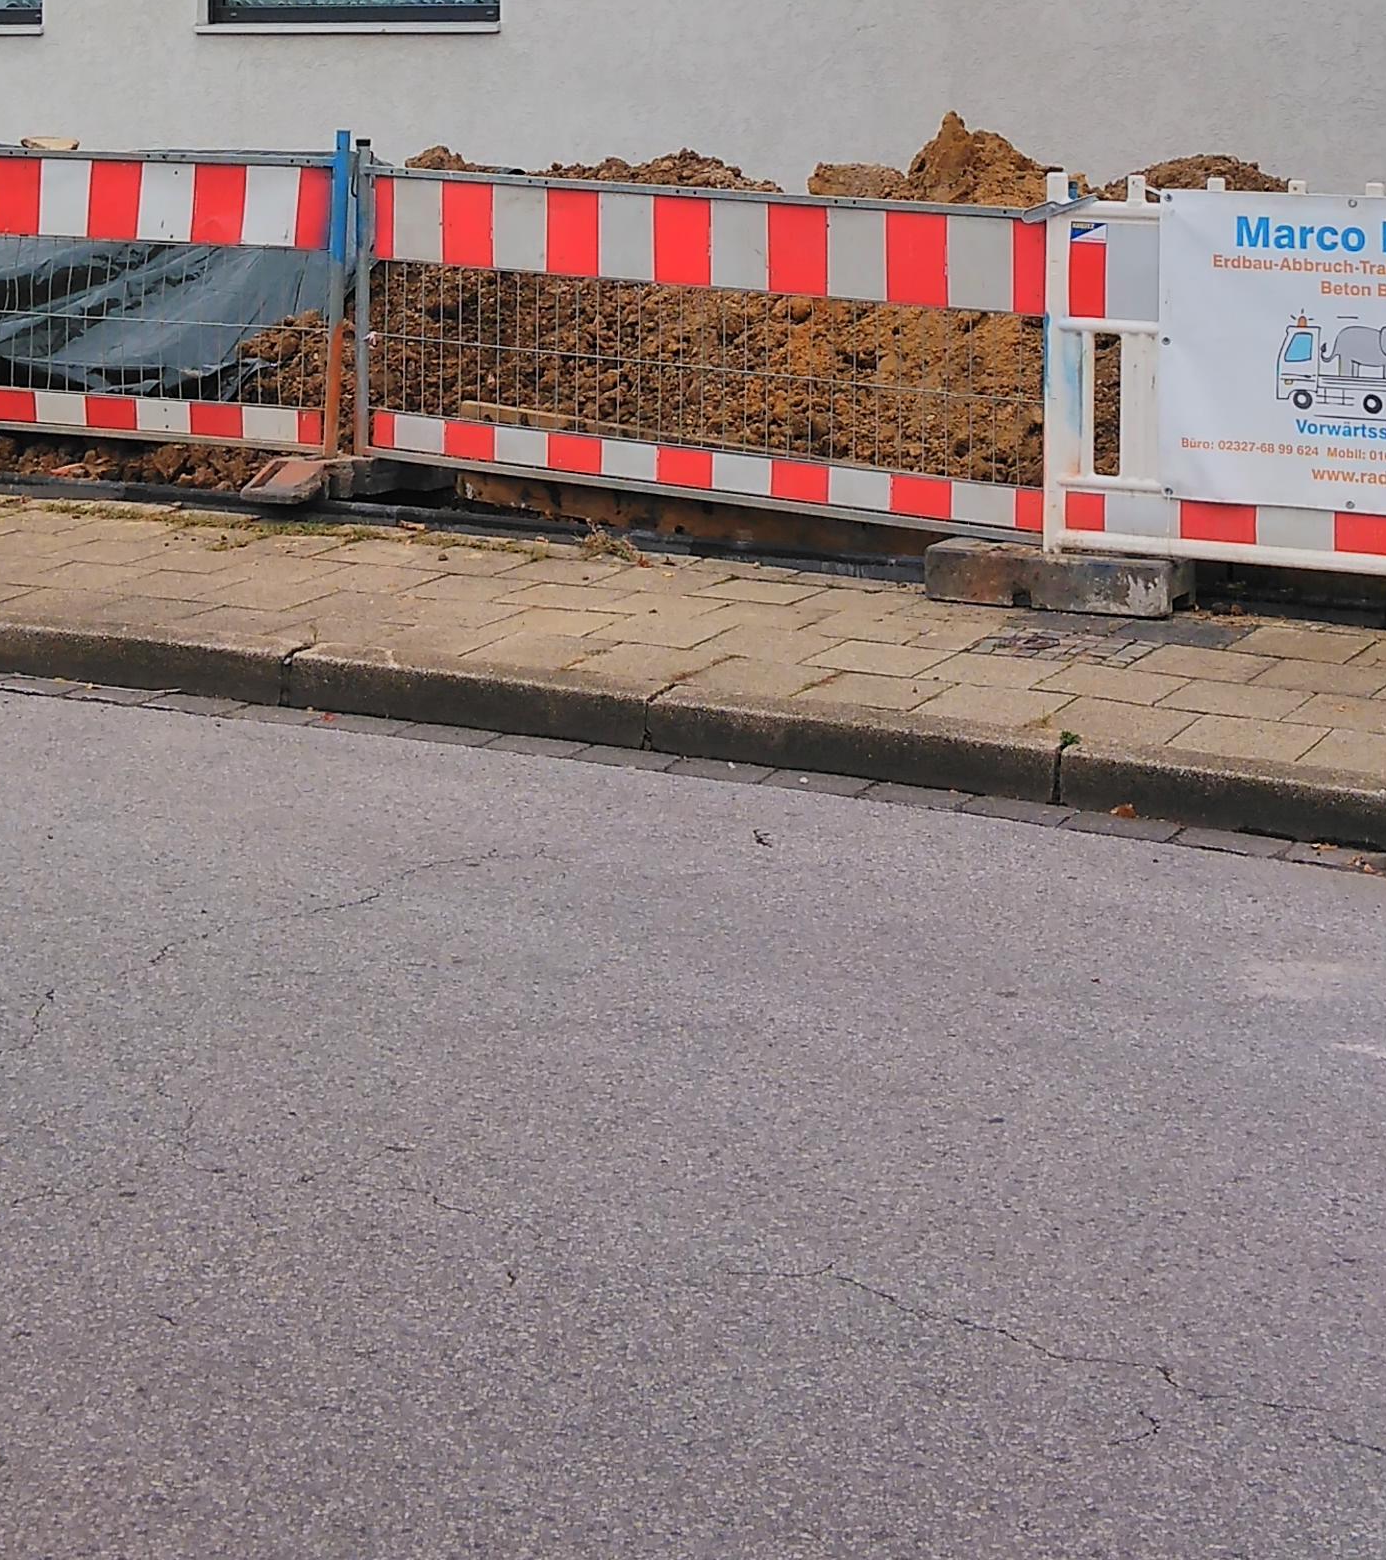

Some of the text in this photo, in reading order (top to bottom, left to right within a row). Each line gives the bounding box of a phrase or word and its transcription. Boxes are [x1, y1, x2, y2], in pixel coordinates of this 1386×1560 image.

[1235, 215, 1366, 253] Marco
[1320, 281, 1372, 297] Beton
[1181, 437, 1214, 450] Büro:
[1218, 441, 1274, 454] 02327-68
[1279, 444, 1294, 455] 99
[1296, 445, 1319, 456] 624
[1327, 447, 1365, 460] Mobil:
